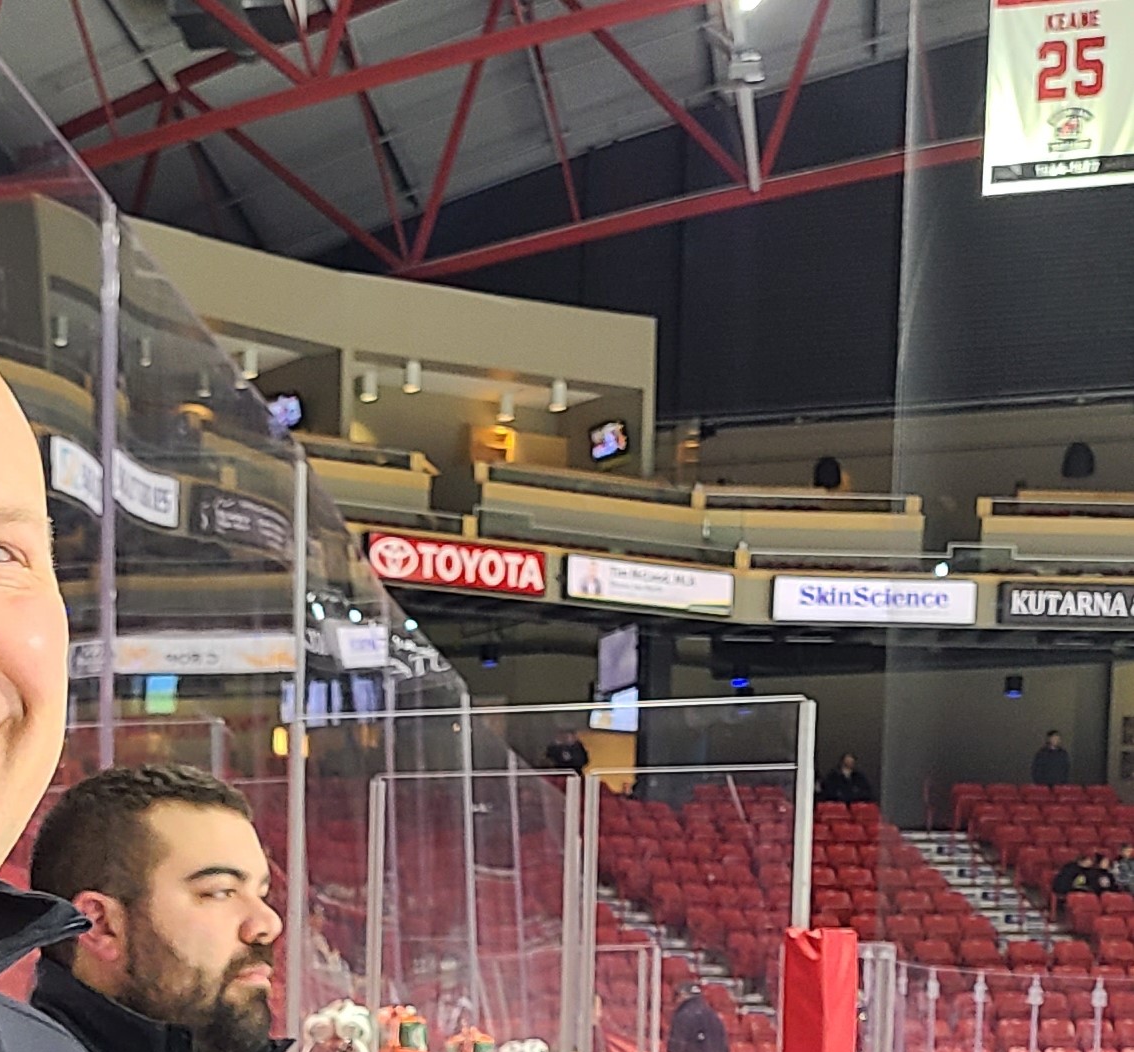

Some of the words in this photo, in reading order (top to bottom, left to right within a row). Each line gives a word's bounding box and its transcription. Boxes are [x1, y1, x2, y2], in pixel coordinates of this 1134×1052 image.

[1037, 36, 1106, 102] 25
[416, 542, 545, 591] TOYOTA
[799, 585, 950, 608] SkinScience
[1011, 589, 1129, 617] KUTARNA
